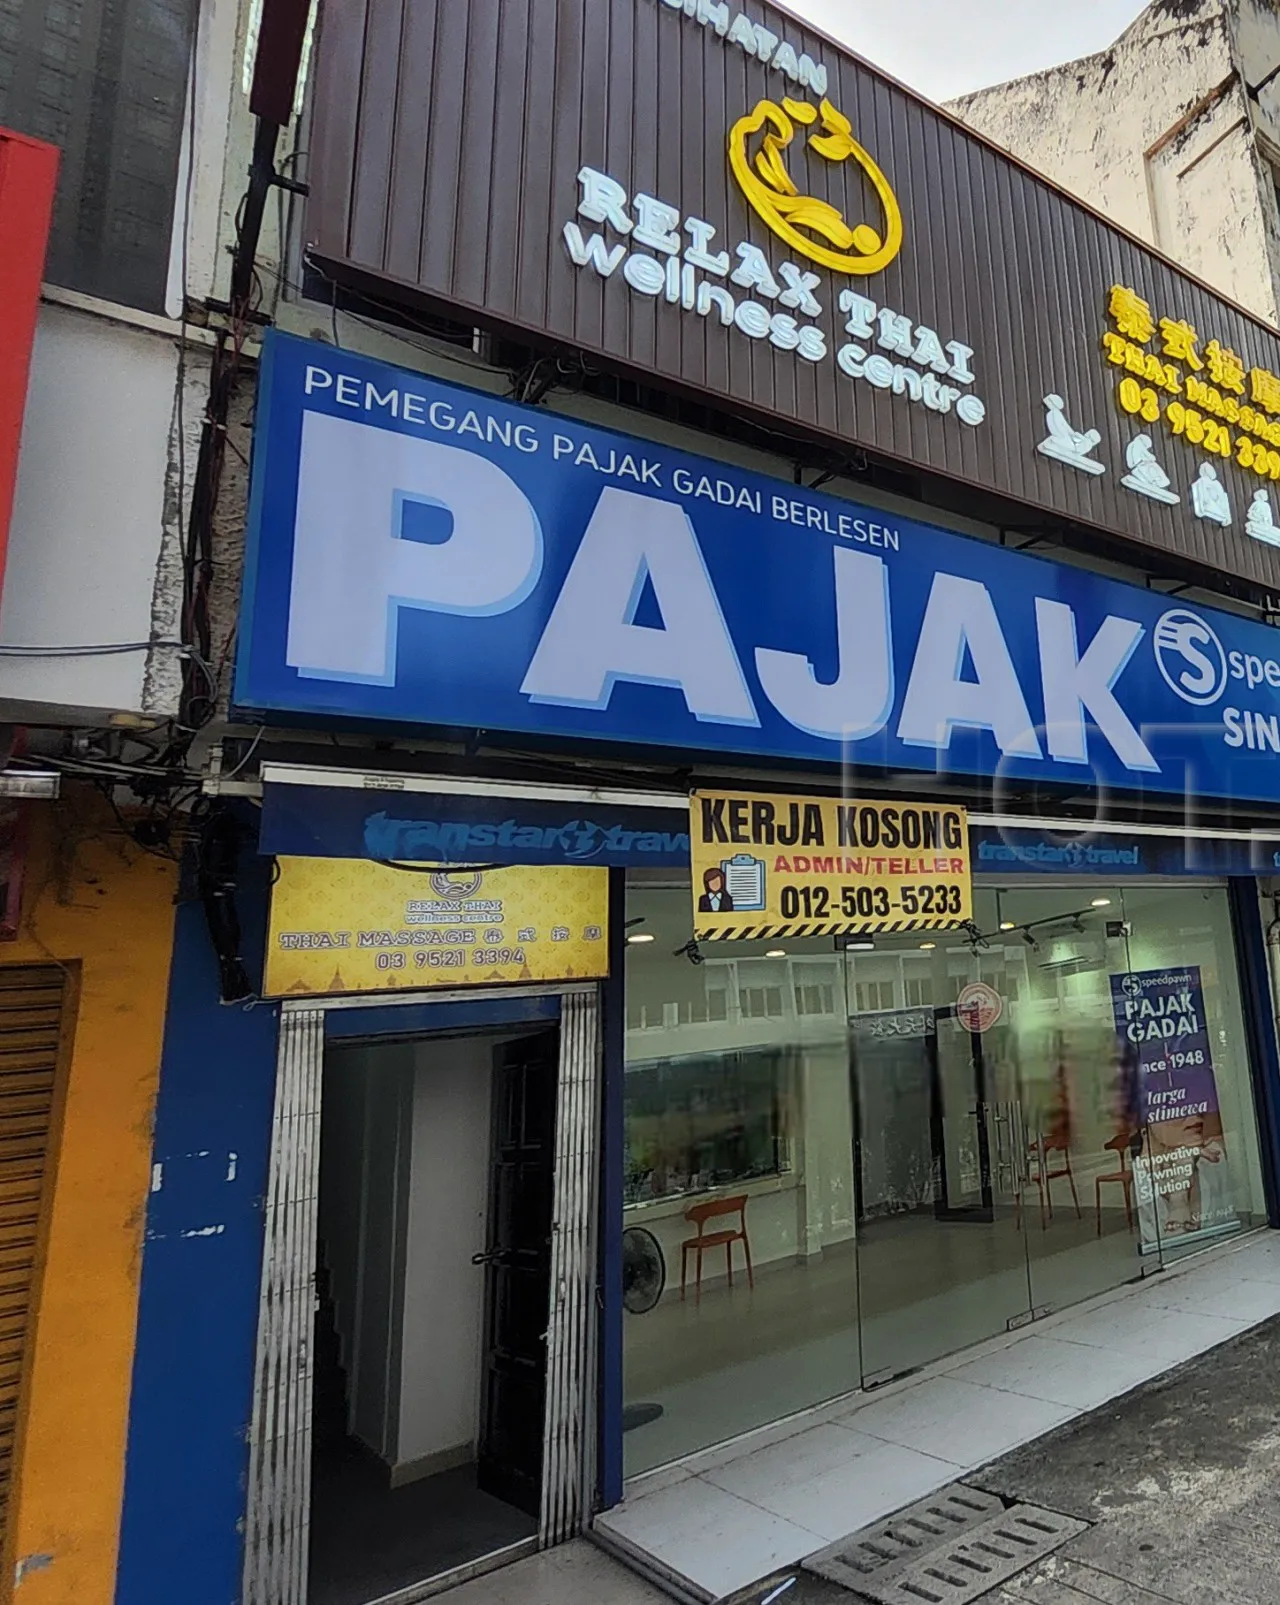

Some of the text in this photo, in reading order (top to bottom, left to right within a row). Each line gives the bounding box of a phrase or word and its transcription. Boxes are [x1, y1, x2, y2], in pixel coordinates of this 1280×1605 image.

[660, 0, 828, 96] IHATAN
[577, 166, 975, 385] RELAX THAI
[563, 222, 986, 426] wellness centre
[1103, 331, 1183, 394] THAI
[1119, 377, 1160, 422] 03
[1166, 402, 1231, 457] 9521
[304, 365, 900, 551] PEMEGANG PAJAK GADAI BERLESEN
[285, 409, 1162, 774] PAJAK
[701, 799, 963, 850] KERJA KOSONG
[773, 855, 964, 875] ADMIN/TELLER
[1086, 847, 1139, 866] travel
[408, 900, 502, 912] RELAX THAI
[780, 884, 962, 919] 012-503-5233
[405, 913, 503, 923] wellness centre
[279, 929, 476, 949] THAI MASSAGE
[376, 948, 526, 969] 03 9521 3394
[1141, 973, 1192, 988] speedpawn
[1124, 993, 1195, 1021] PAJAK
[1126, 1014, 1198, 1043] GADAI
[1169, 1050, 1204, 1068] 1948
[1135, 1146, 1200, 1169] Innovative
